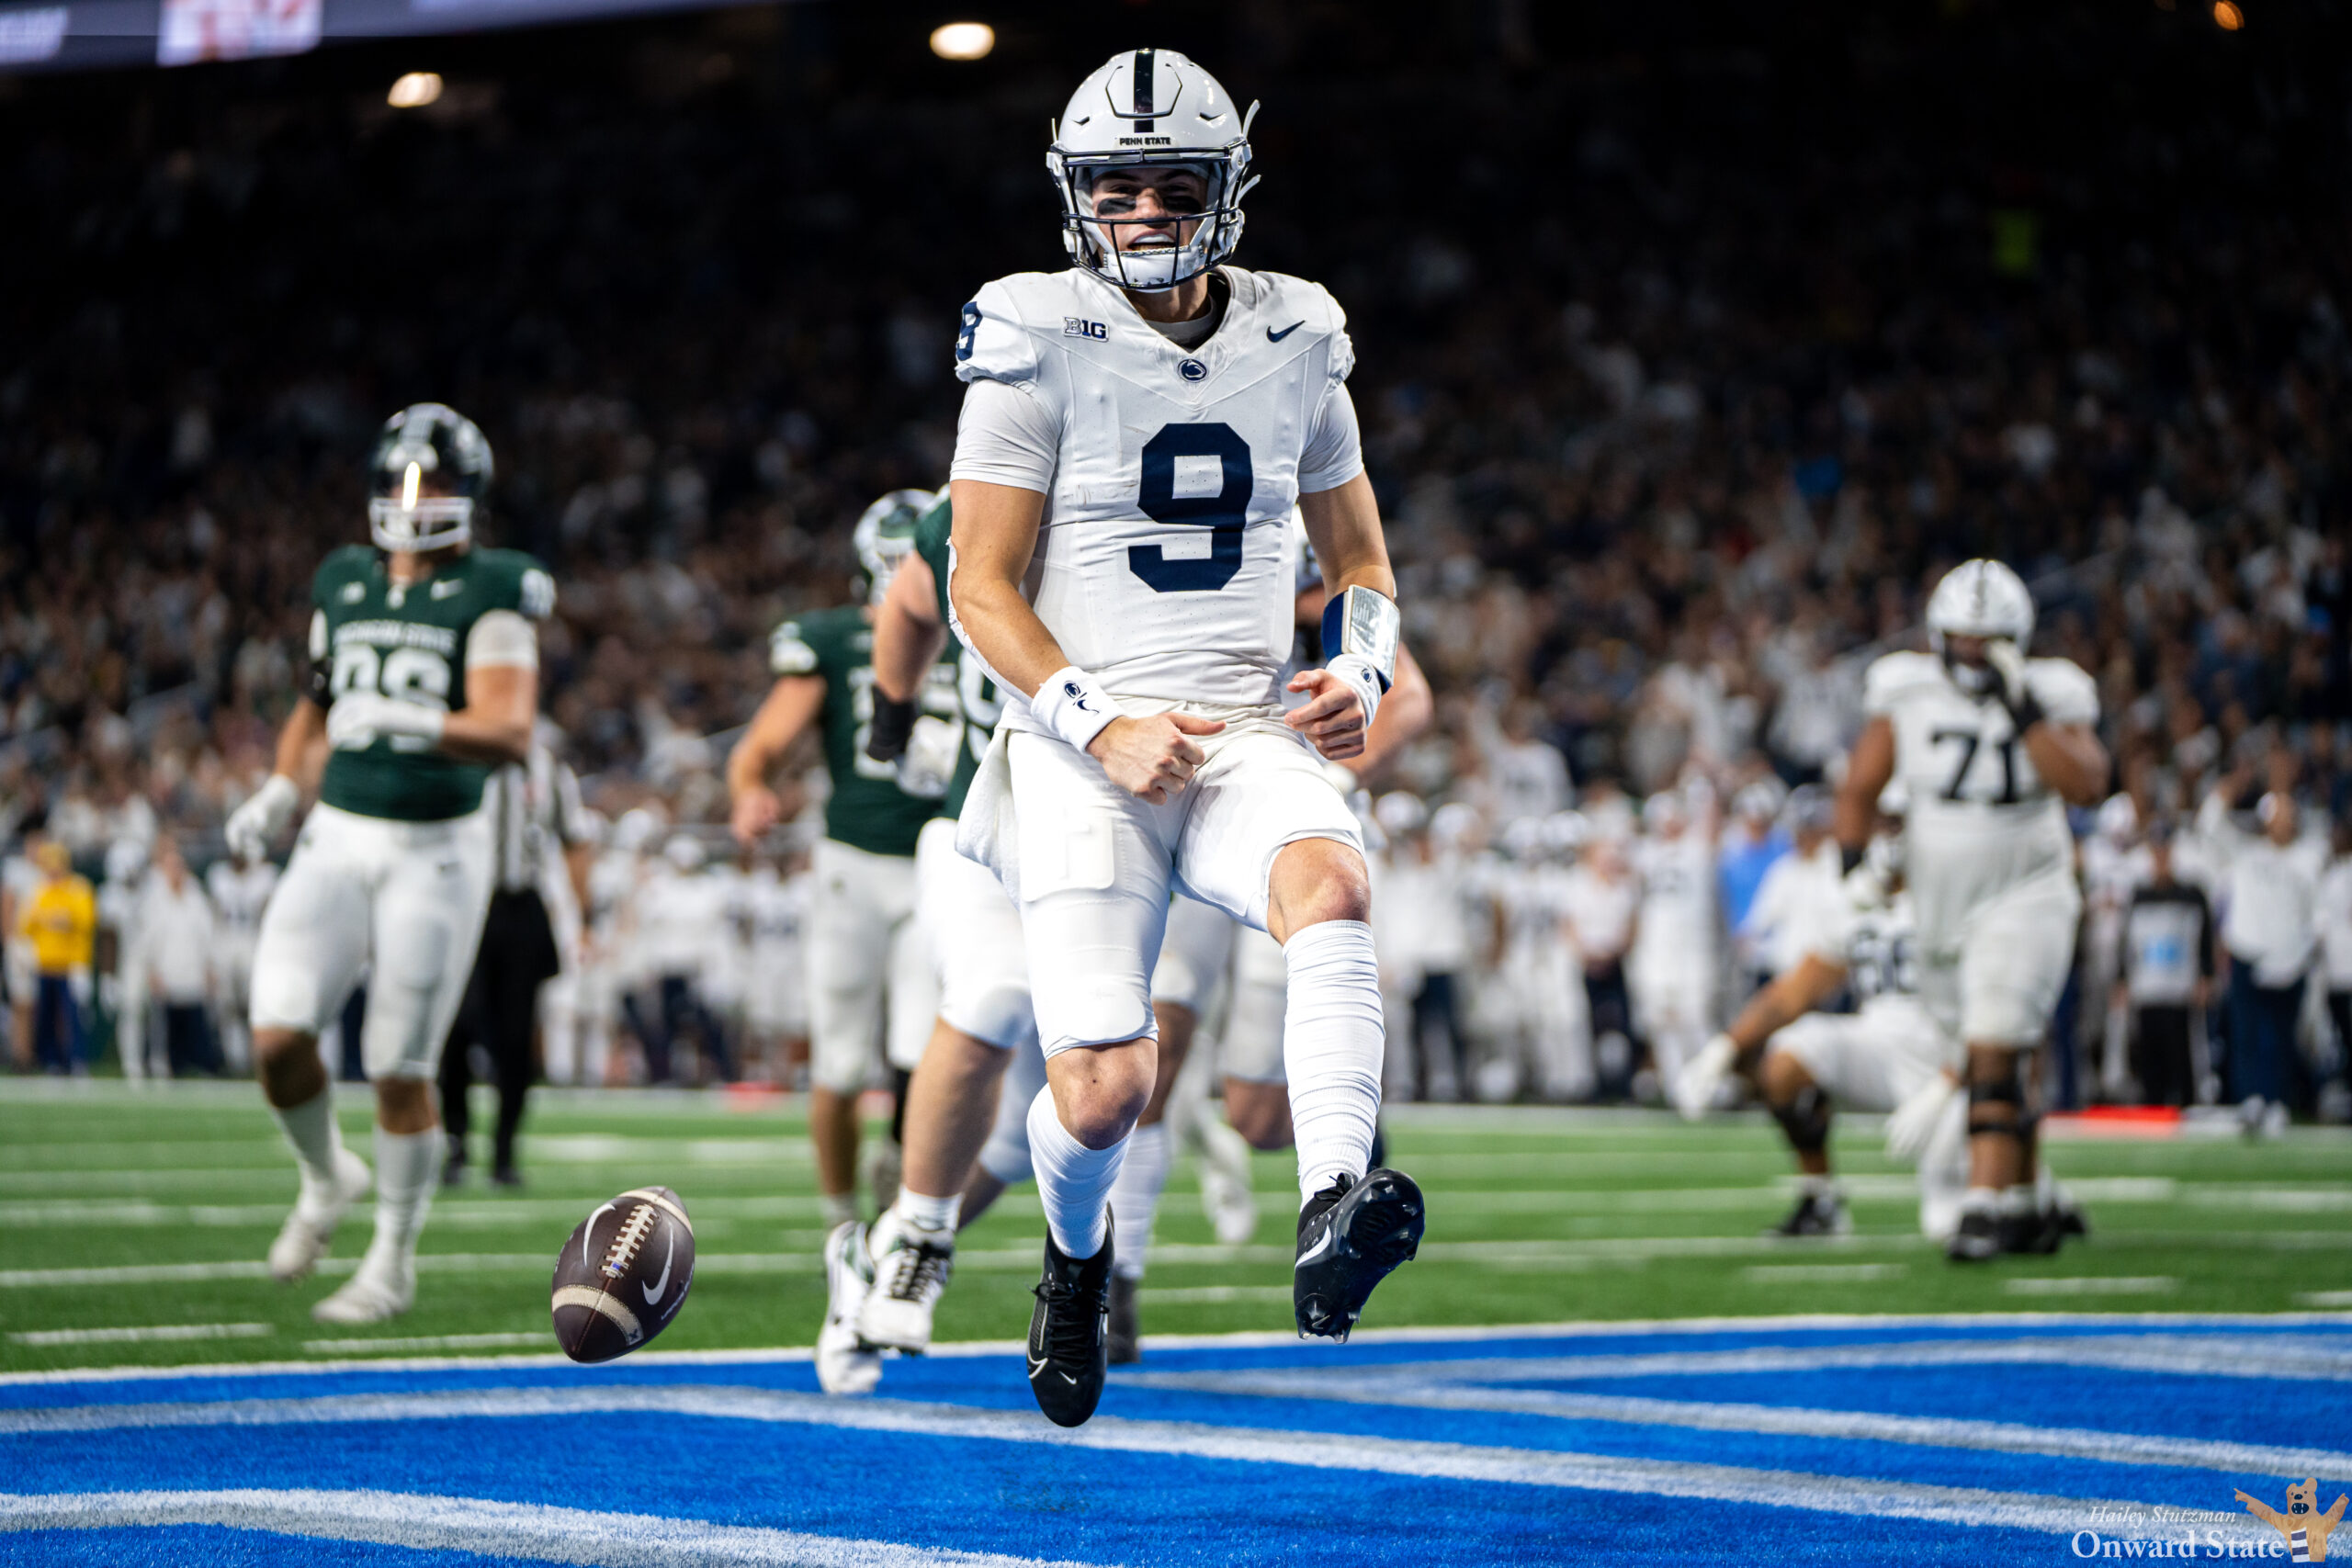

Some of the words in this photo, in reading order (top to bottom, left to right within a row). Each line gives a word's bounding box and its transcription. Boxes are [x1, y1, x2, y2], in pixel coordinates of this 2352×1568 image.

[1119, 137, 1143, 146] PENN
[1144, 136, 1171, 145] STATE
[1127, 422, 1253, 592] 9
[1930, 728, 2022, 805] 71
